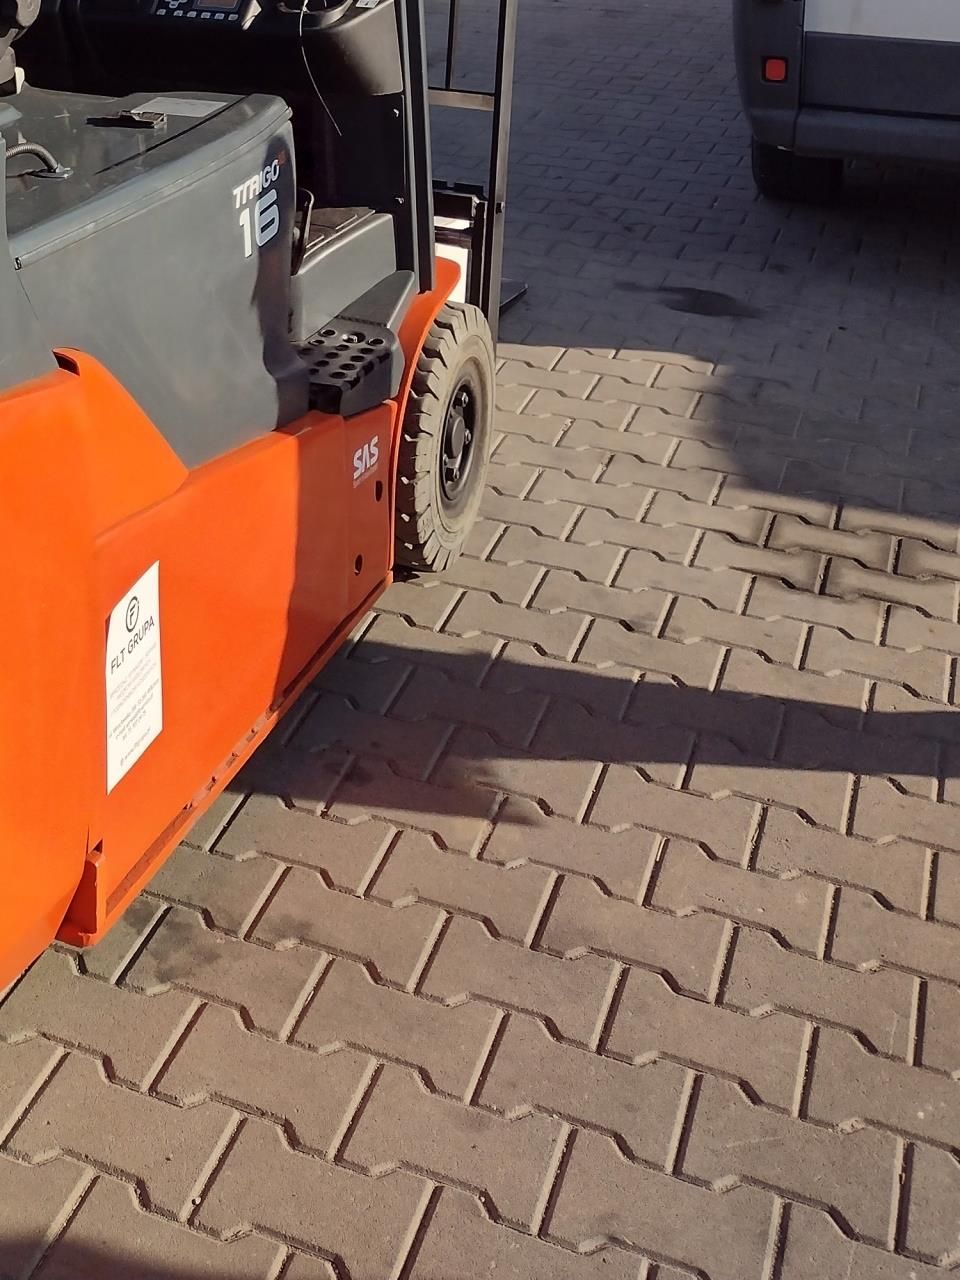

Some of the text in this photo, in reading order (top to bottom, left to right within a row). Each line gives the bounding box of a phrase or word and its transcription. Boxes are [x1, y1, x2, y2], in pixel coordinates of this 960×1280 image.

[232, 159, 280, 209] TRAIGO
[239, 188, 280, 258] 16
[353, 434, 379, 480] SAS
[110, 647, 126, 675] FLT
[127, 615, 155, 655] GRUPA
